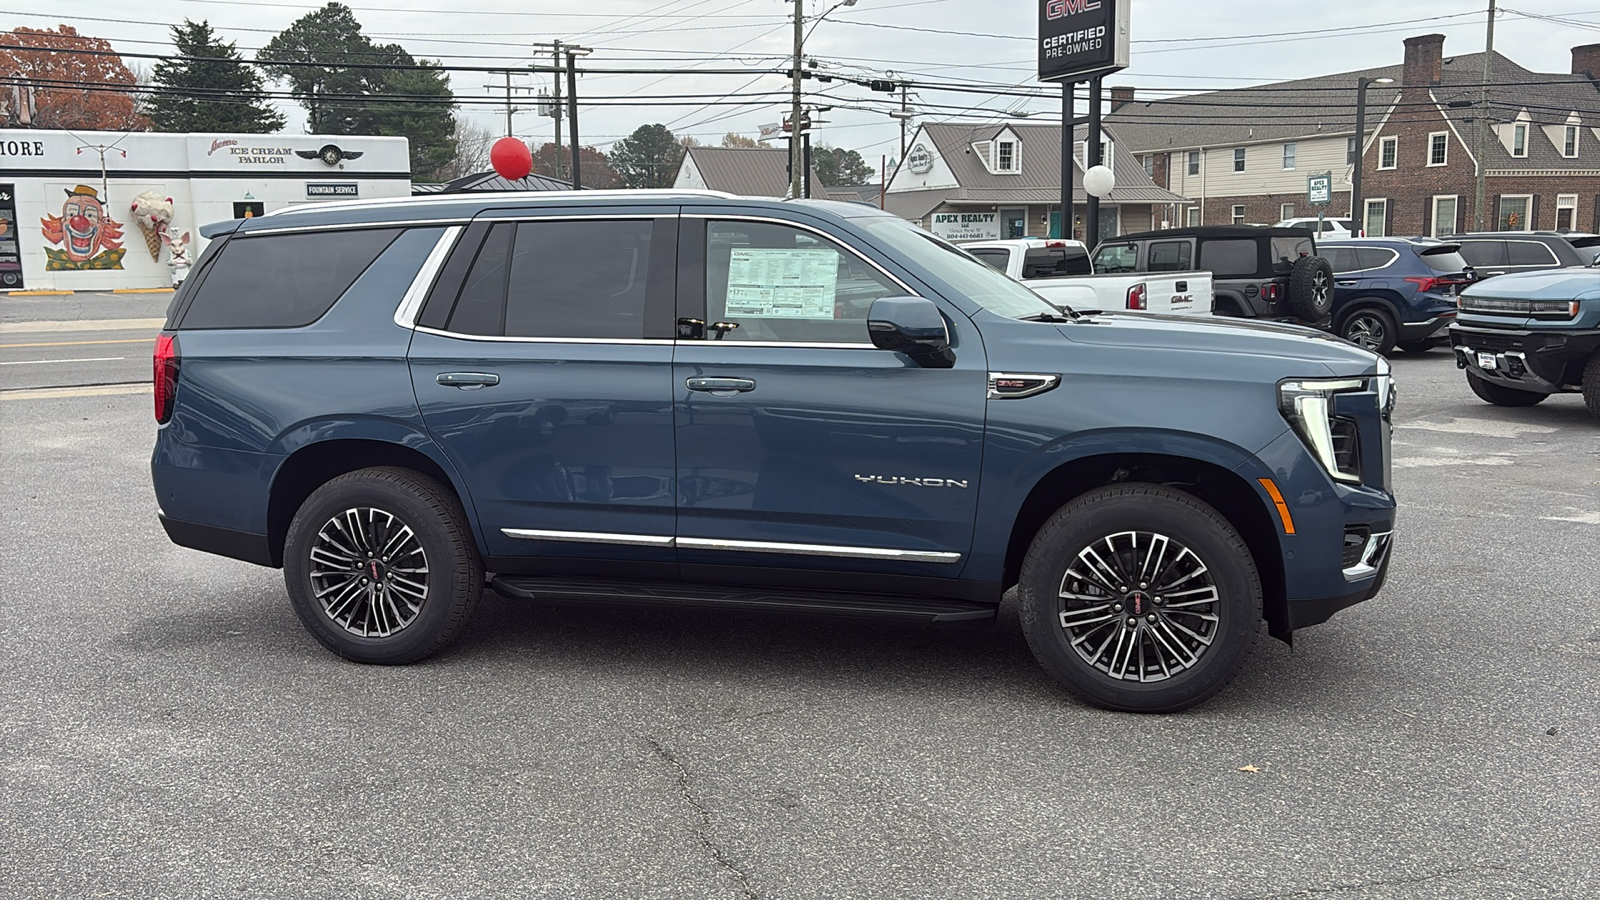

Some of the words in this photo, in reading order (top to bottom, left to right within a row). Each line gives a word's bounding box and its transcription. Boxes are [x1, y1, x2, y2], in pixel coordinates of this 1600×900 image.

[1043, 26, 1106, 49] CERTIFIED
[1046, 38, 1102, 59] PRE-OWNED
[230, 147, 248, 155] ICE
[251, 147, 292, 155] CREAM
[238, 156, 285, 164] PARLOR
[308, 186, 335, 194] FOUNTAIN
[335, 186, 357, 194] SERVICE
[935, 214, 959, 223] APEX
[961, 214, 995, 223] REALTY
[1170, 294, 1193, 304] GMC
[854, 473, 968, 489] YUKON
